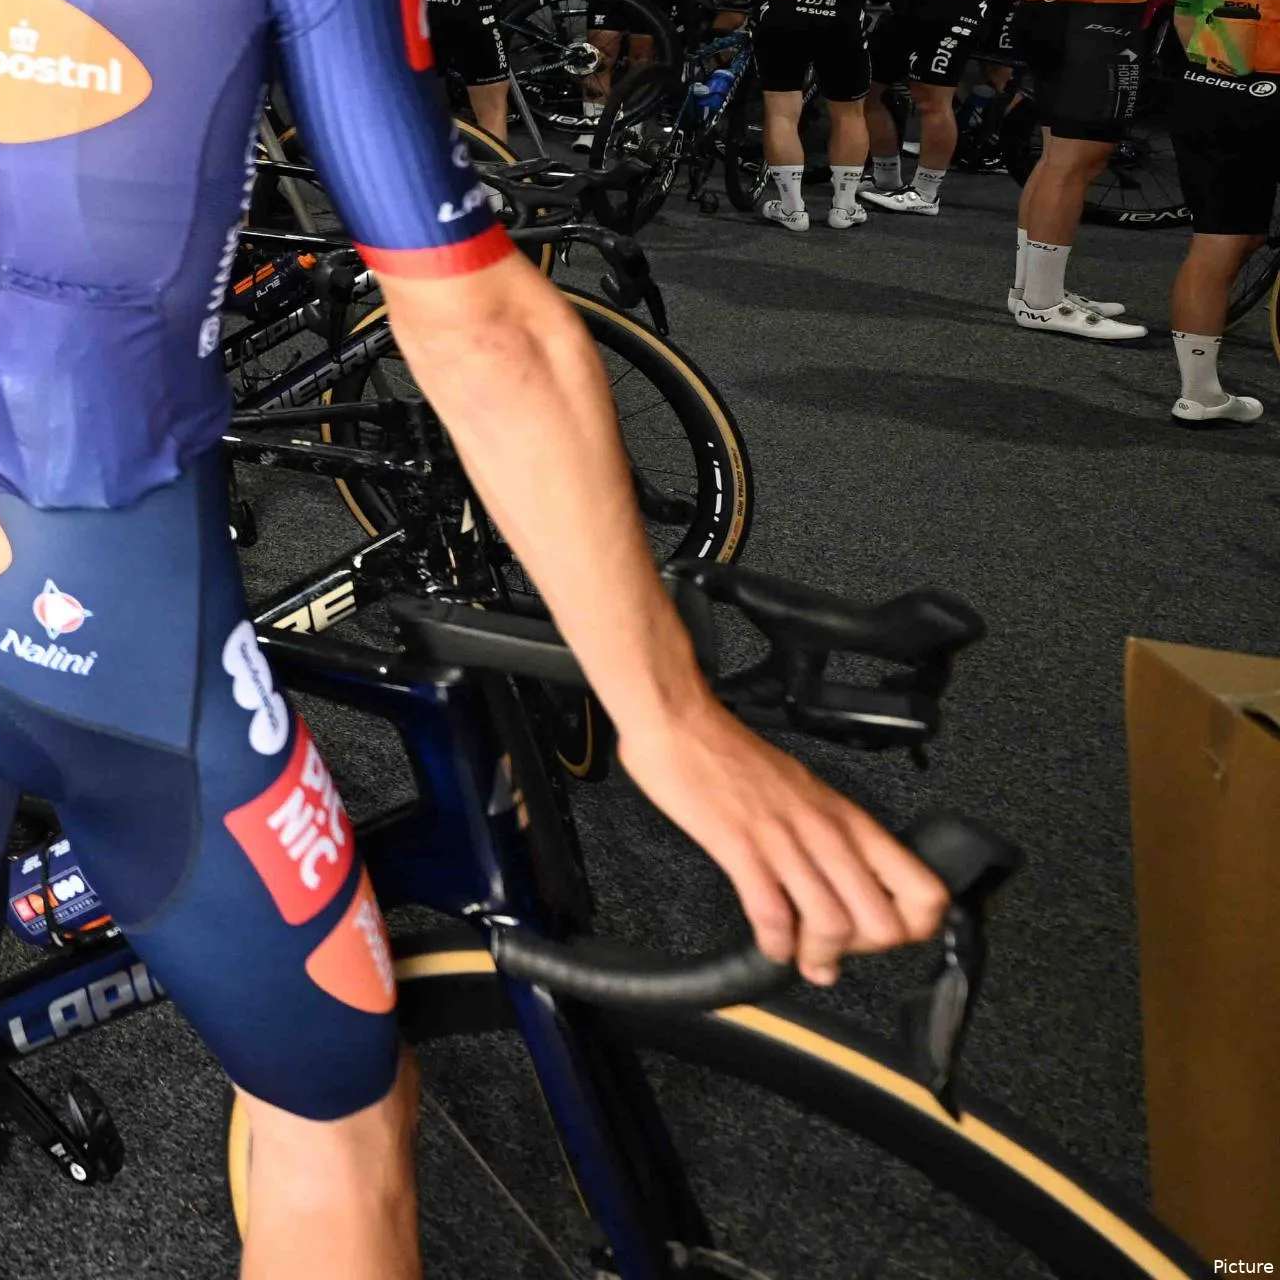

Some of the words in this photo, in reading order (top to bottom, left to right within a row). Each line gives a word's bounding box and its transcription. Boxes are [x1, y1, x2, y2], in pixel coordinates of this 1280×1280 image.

[1084, 23, 1131, 37] POLI
[931, 48, 953, 74] FDJ
[1118, 64, 1128, 91] HOME
